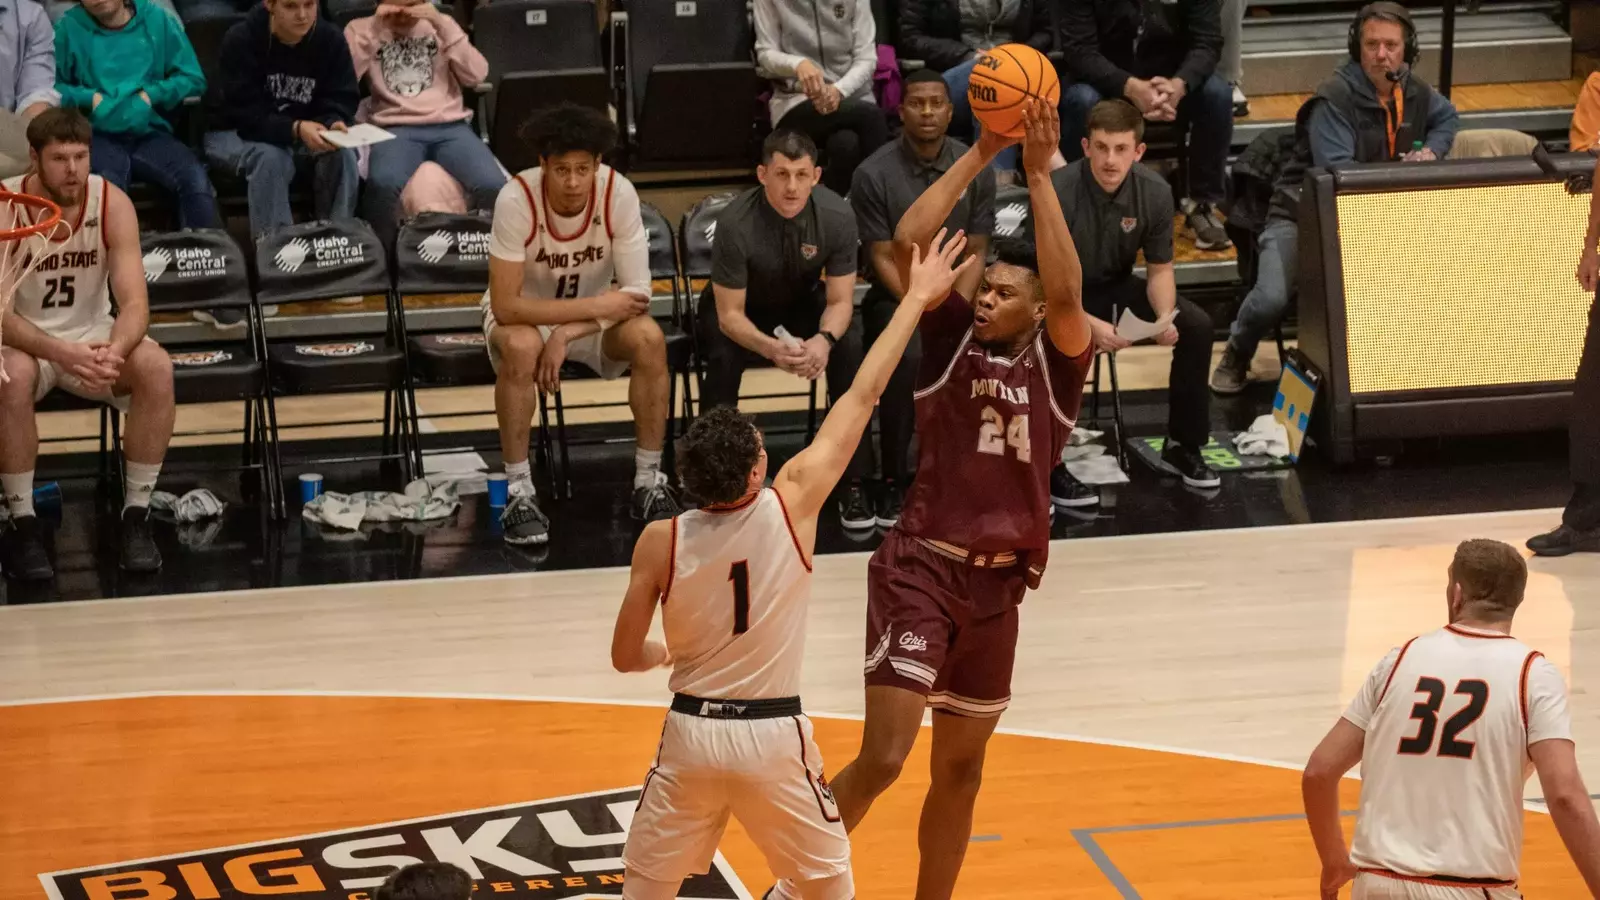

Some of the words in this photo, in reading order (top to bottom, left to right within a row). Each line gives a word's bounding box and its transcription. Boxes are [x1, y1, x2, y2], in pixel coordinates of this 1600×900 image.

[313, 235, 348, 249] Idaho
[457, 231, 491, 242] Idaho
[175, 246, 211, 259] Idaho
[316, 243, 363, 260] Central
[459, 241, 488, 253] Cent
[61, 249, 98, 268] STATE
[177, 255, 226, 270] Central
[317, 259, 340, 268] CREDIT
[343, 256, 364, 264] UNION
[178, 270, 202, 278] CREDIT
[42, 276, 75, 309] 25
[555, 273, 579, 298] 13
[977, 405, 1031, 463] 24
[727, 559, 750, 636] 1
[899, 631, 927, 651] Griz
[1397, 676, 1489, 760] 32
[80, 848, 326, 900] BIG
